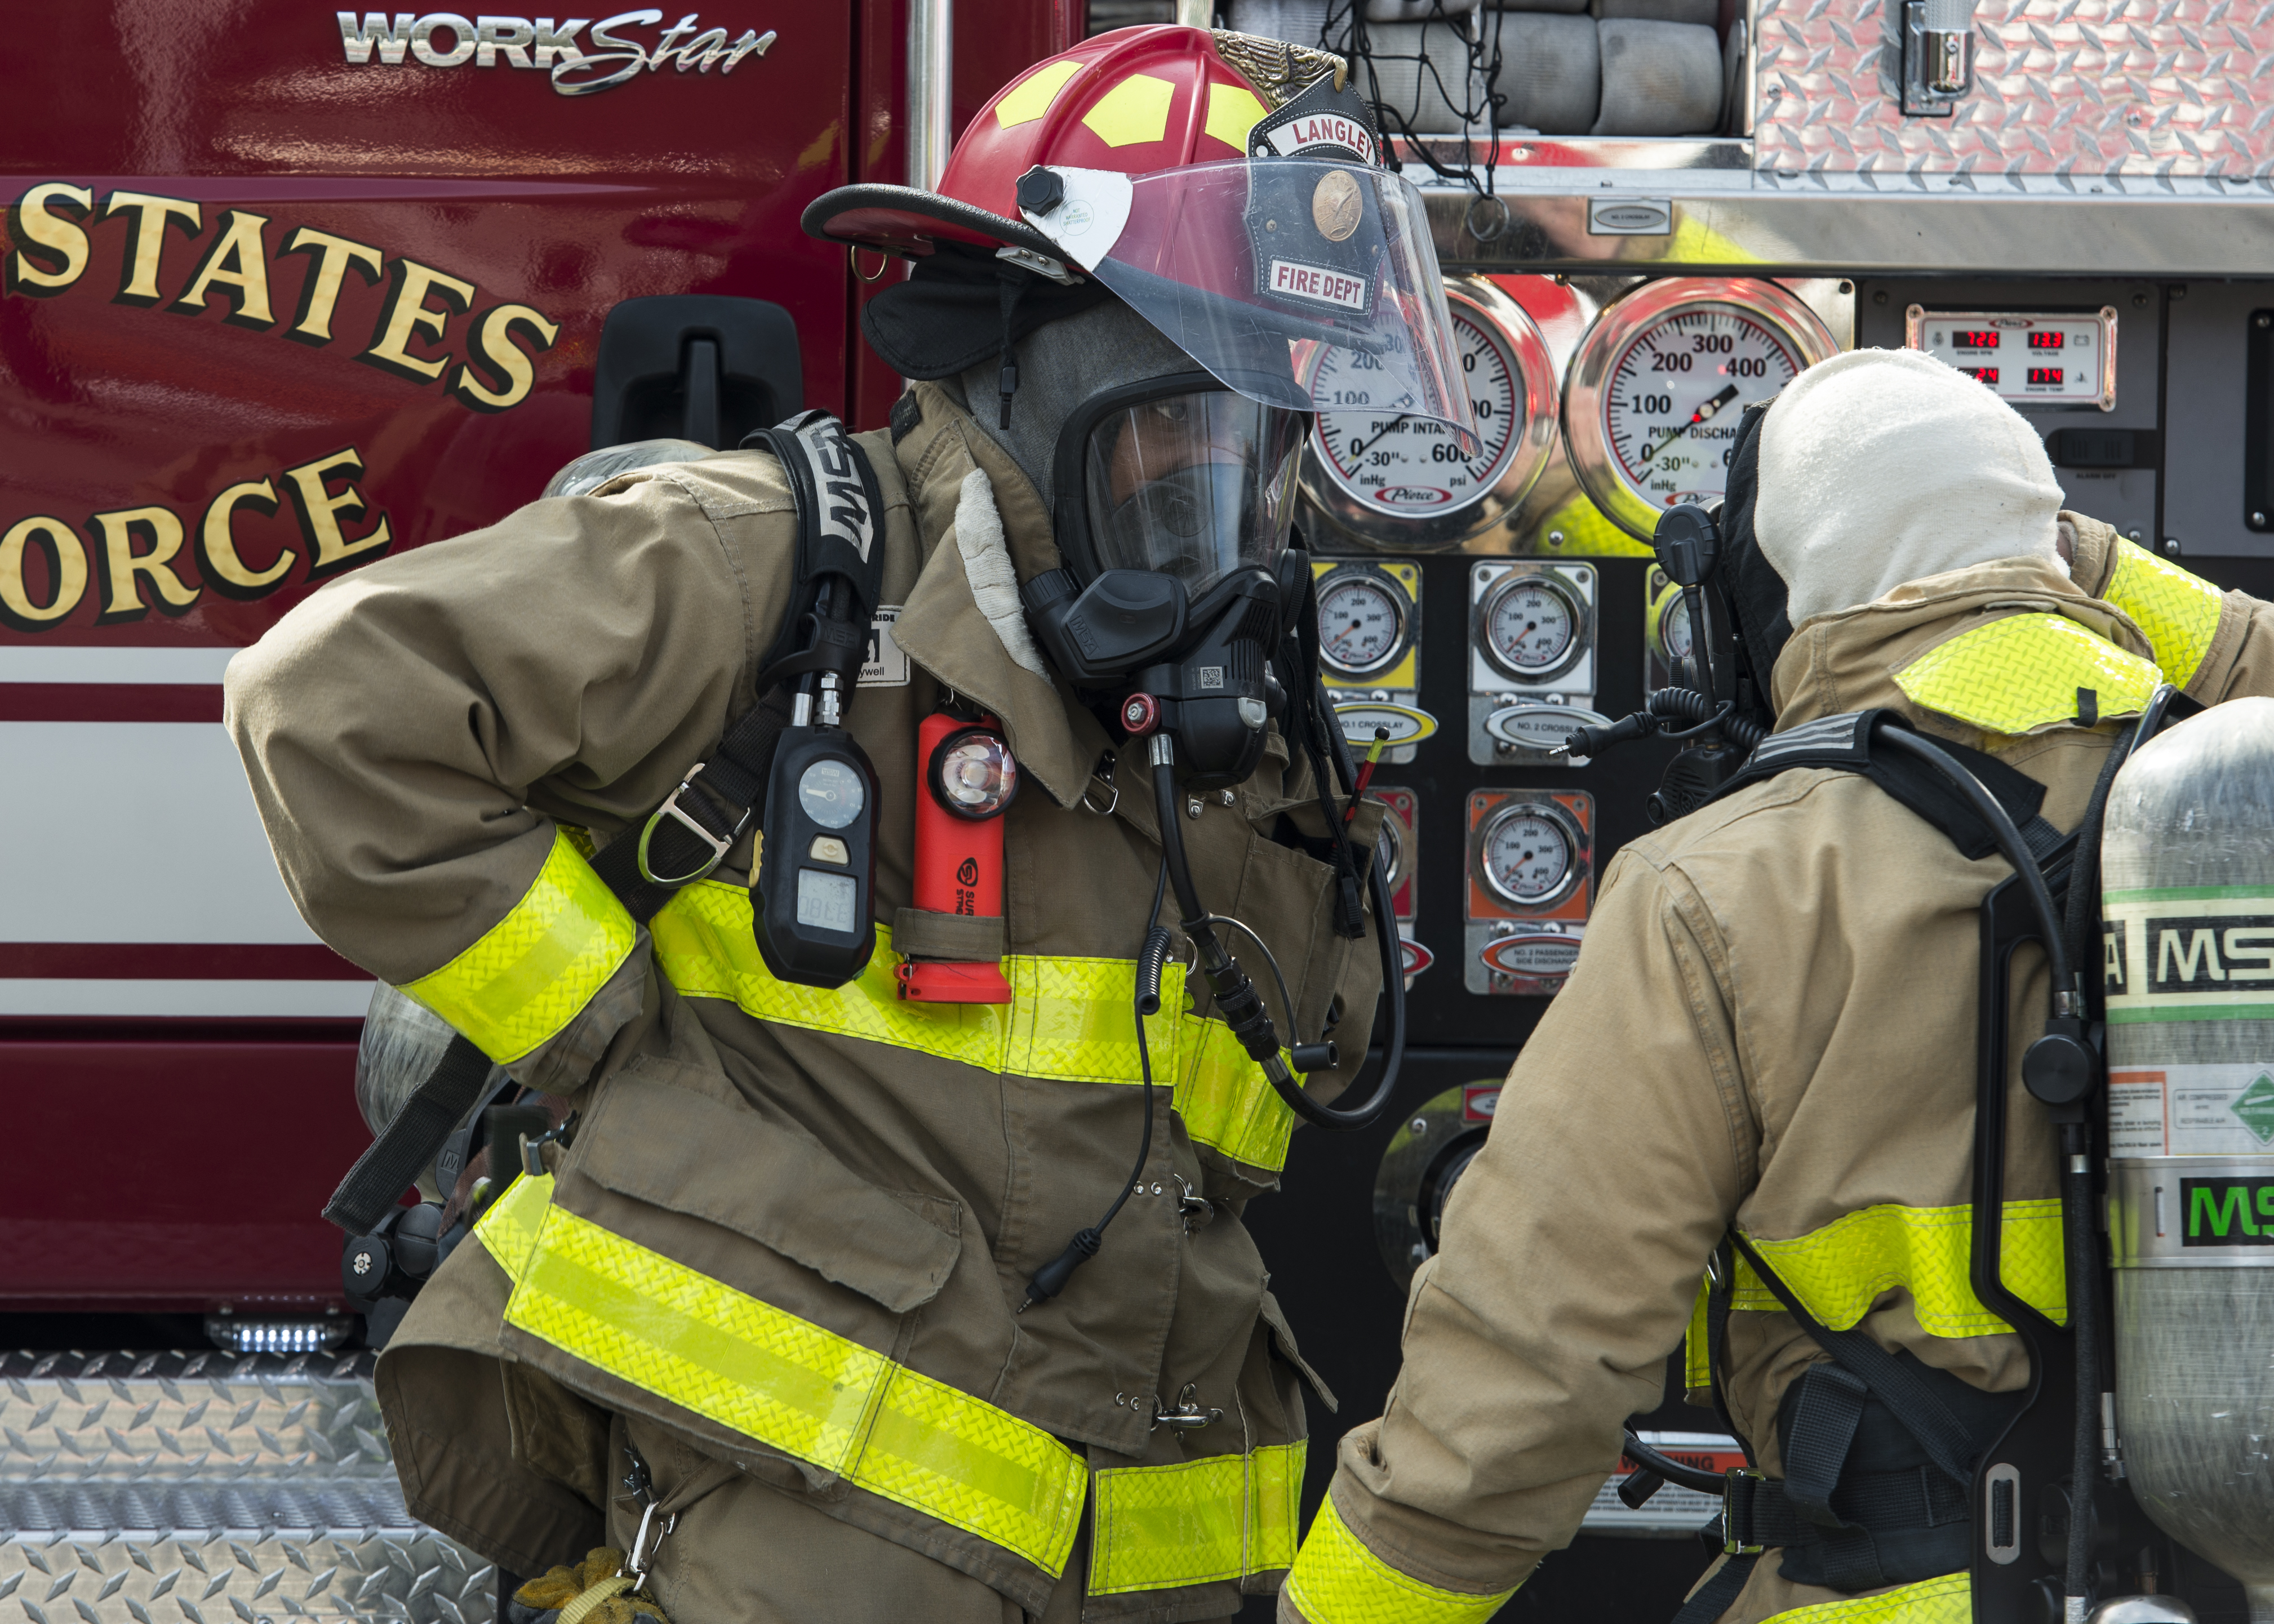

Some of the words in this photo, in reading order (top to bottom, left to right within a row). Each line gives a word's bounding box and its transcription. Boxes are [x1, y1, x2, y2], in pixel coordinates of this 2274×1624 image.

[1292, 118, 1373, 160] LANGLEY
[1063, 217, 1091, 226] SHATTERPROOF
[1277, 266, 1321, 295] FIRE
[1323, 275, 1361, 304] DEPT
[11, 181, 562, 411] STATES
[1692, 333, 1733, 353] 300
[1967, 331, 1997, 347] 726
[1651, 352, 1693, 372] 200
[1726, 358, 1766, 377] 400
[2033, 368, 2062, 381] 174
[1333, 390, 1370, 406] 100
[1632, 394, 1671, 413] 100
[1371, 421, 1409, 434] PUMP
[1413, 422, 1446, 434] INTA
[1690, 426, 1737, 439] DISCHA
[1350, 438, 1364, 457] 0
[1641, 443, 1654, 462] 0
[1360, 474, 1386, 488] inHg
[1450, 476, 1467, 488] psi
[1651, 479, 1676, 492] inHg
[1392, 488, 1434, 502] Pierce
[0, 447, 392, 626] ORCE
[1072, 620, 1096, 653] MSA
[859, 666, 885, 678] ywell
[1534, 723, 1540, 731] 2
[1541, 723, 1579, 733] CROSSL
[822, 768, 840, 777] MSA
[965, 891, 975, 916] SUR
[2156, 928, 2274, 983] MS
[2189, 1186, 2274, 1237] M
